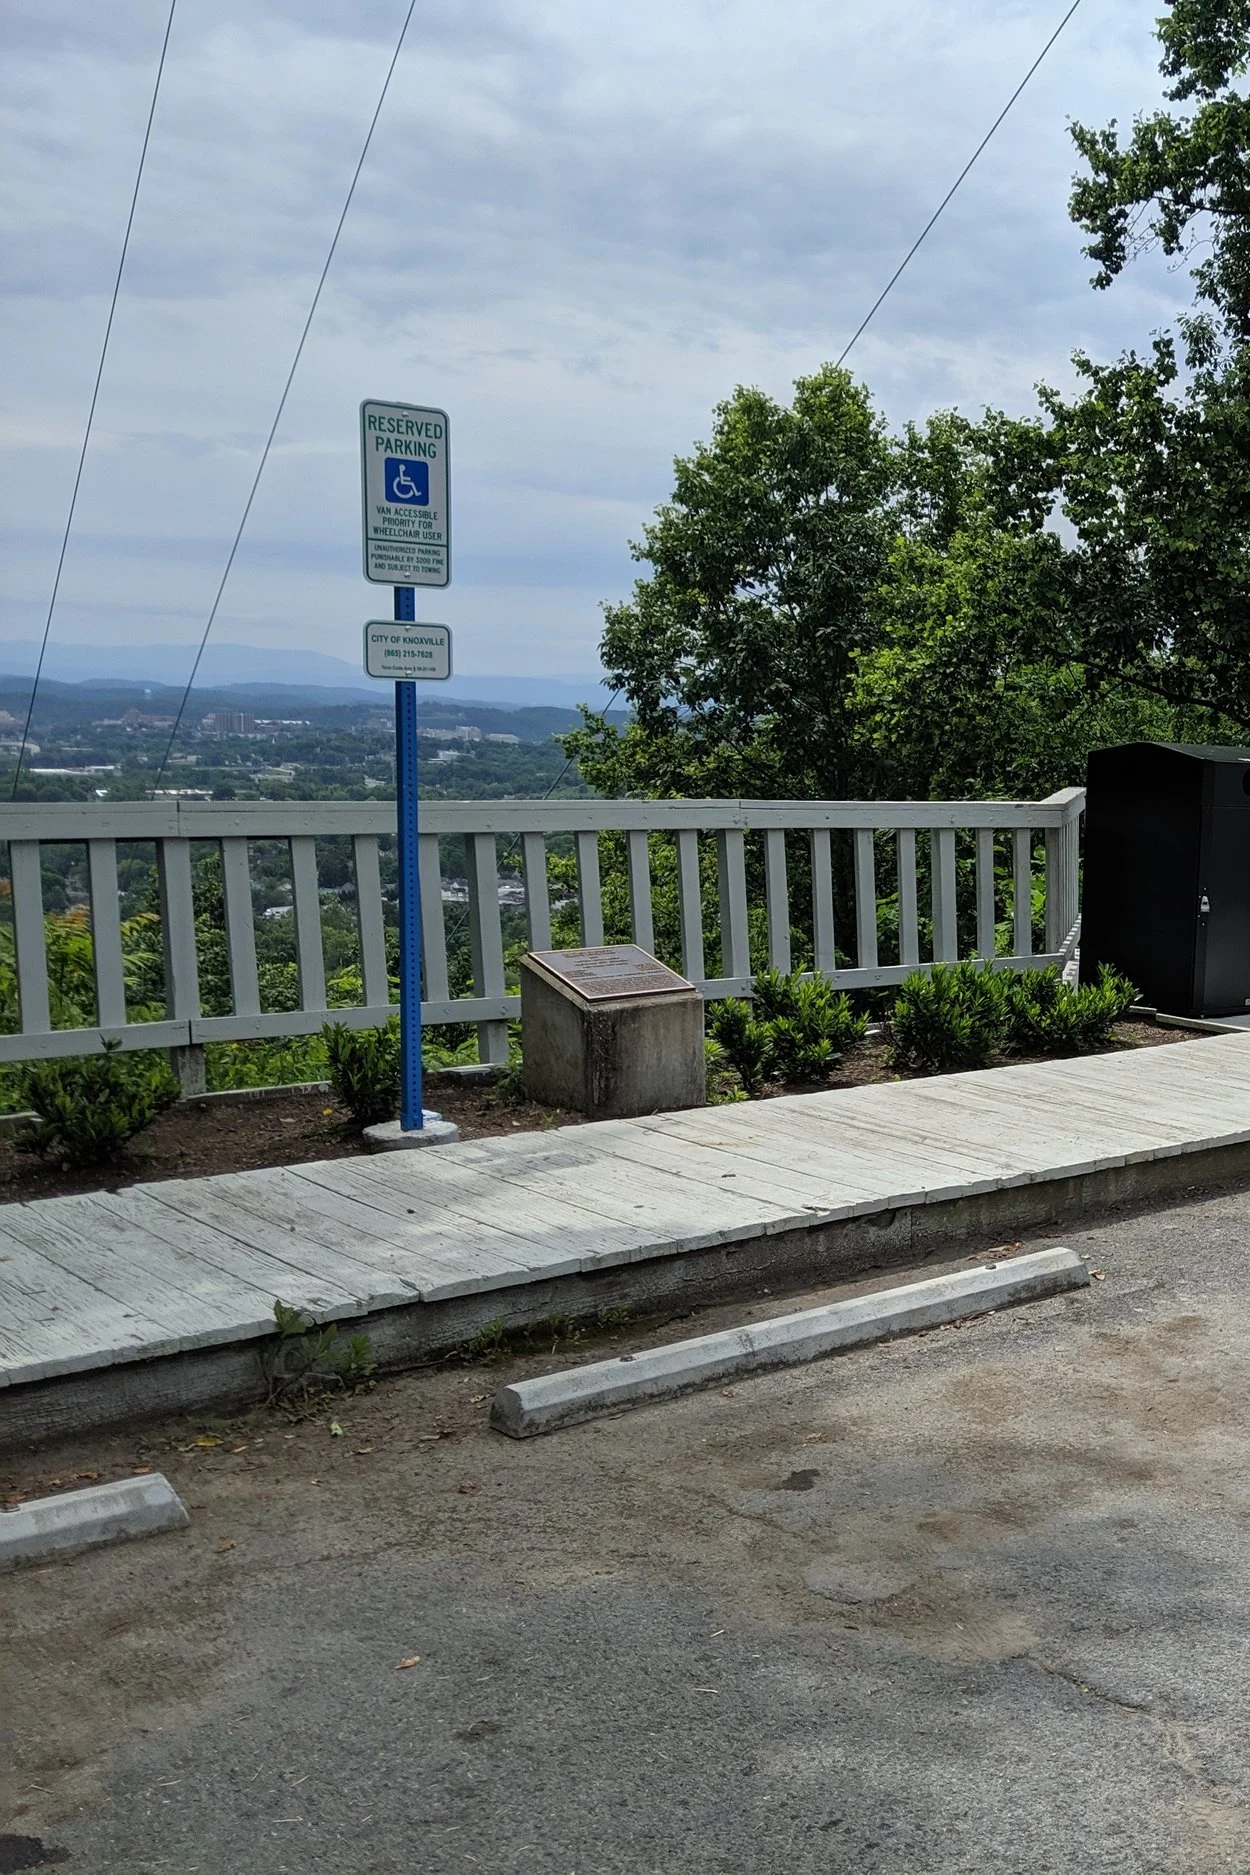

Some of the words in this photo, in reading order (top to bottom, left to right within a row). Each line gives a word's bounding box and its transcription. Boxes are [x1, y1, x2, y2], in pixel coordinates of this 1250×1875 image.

[368, 414, 443, 440] RESERVED
[375, 435, 437, 459] PARKING
[376, 505, 392, 516] VAN
[394, 507, 438, 521] ACCESSIBLE
[382, 516, 416, 529] PRIORITY
[418, 520, 433, 530] FOR
[373, 526, 421, 539] WHEELCHAIR
[422, 531, 442, 541] USER
[374, 544, 417, 555] UNAUTHORIZED
[417, 548, 441, 557] PARKING
[370, 553, 405, 563] PUNISHABLE
[416, 556, 431, 565] $200
[432, 558, 444, 566] FINE
[374, 562, 386, 570] AND
[387, 563, 411, 572] SUBJECT
[421, 565, 441, 574] TOWING
[371, 634, 389, 644] CITY
[390, 635, 401, 644] OF
[402, 636, 445, 647] KNOXVILLE
[384, 648, 401, 659] (865)
